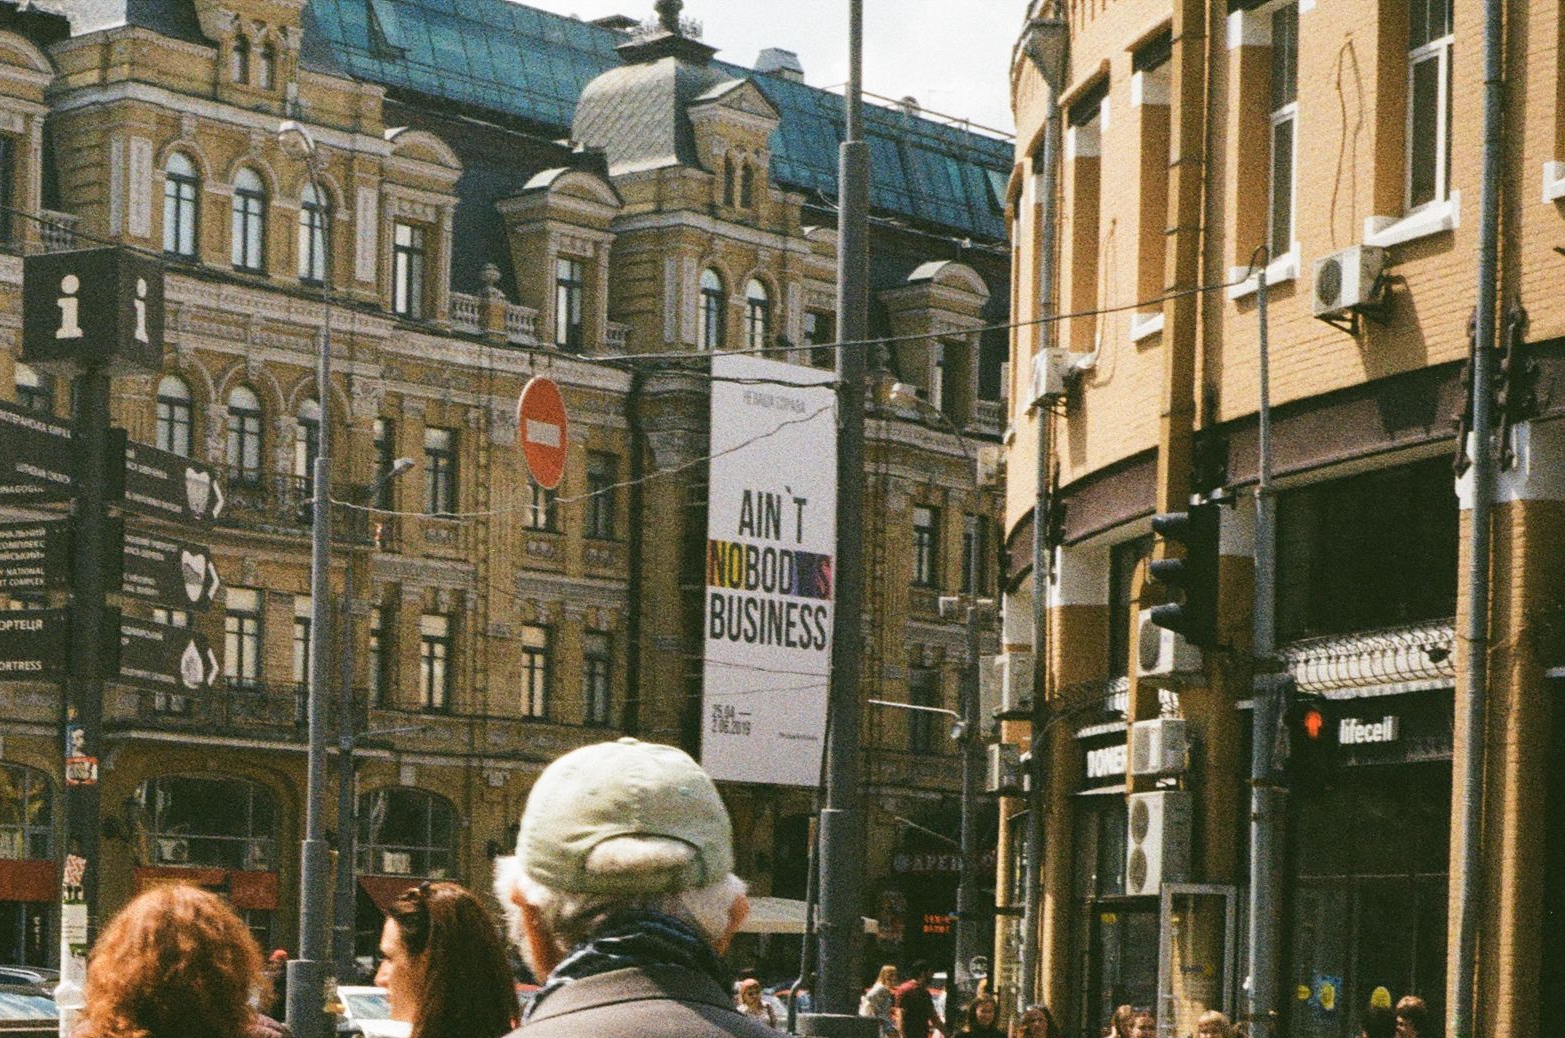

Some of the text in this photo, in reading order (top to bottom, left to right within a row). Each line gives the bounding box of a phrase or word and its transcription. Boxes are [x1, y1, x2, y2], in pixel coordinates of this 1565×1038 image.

[6, 567, 44, 576] NATIONAL
[710, 593, 827, 650] BUSINESS
[1339, 716, 1392, 743] lifecell
